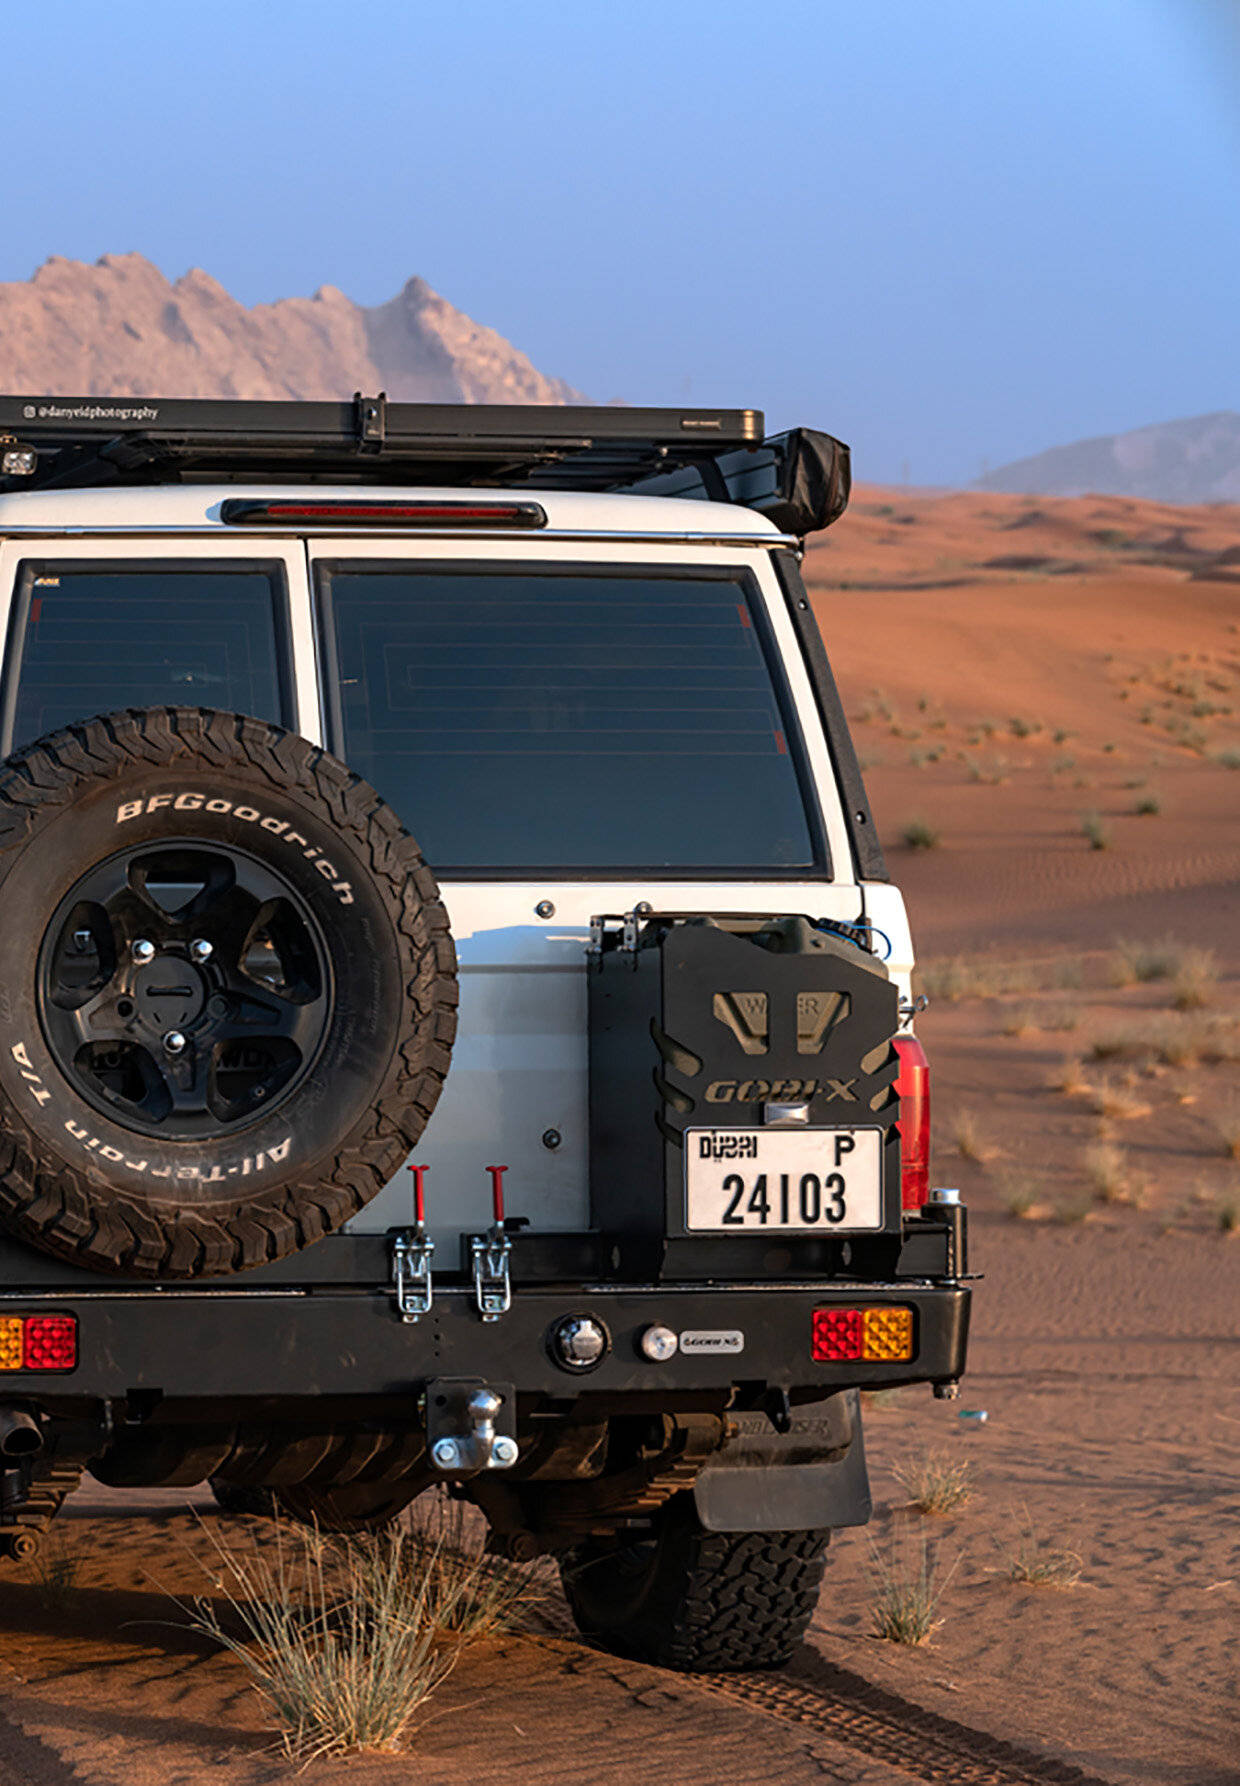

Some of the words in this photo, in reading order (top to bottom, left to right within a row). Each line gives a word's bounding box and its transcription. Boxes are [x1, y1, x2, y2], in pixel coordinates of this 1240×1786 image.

[115, 792, 355, 905] BFGoodrich
[10, 1041, 52, 1107] T/A
[64, 1119, 292, 1184] All-Terrain
[833, 1134, 856, 1167] P
[721, 1172, 847, 1225] 24103
